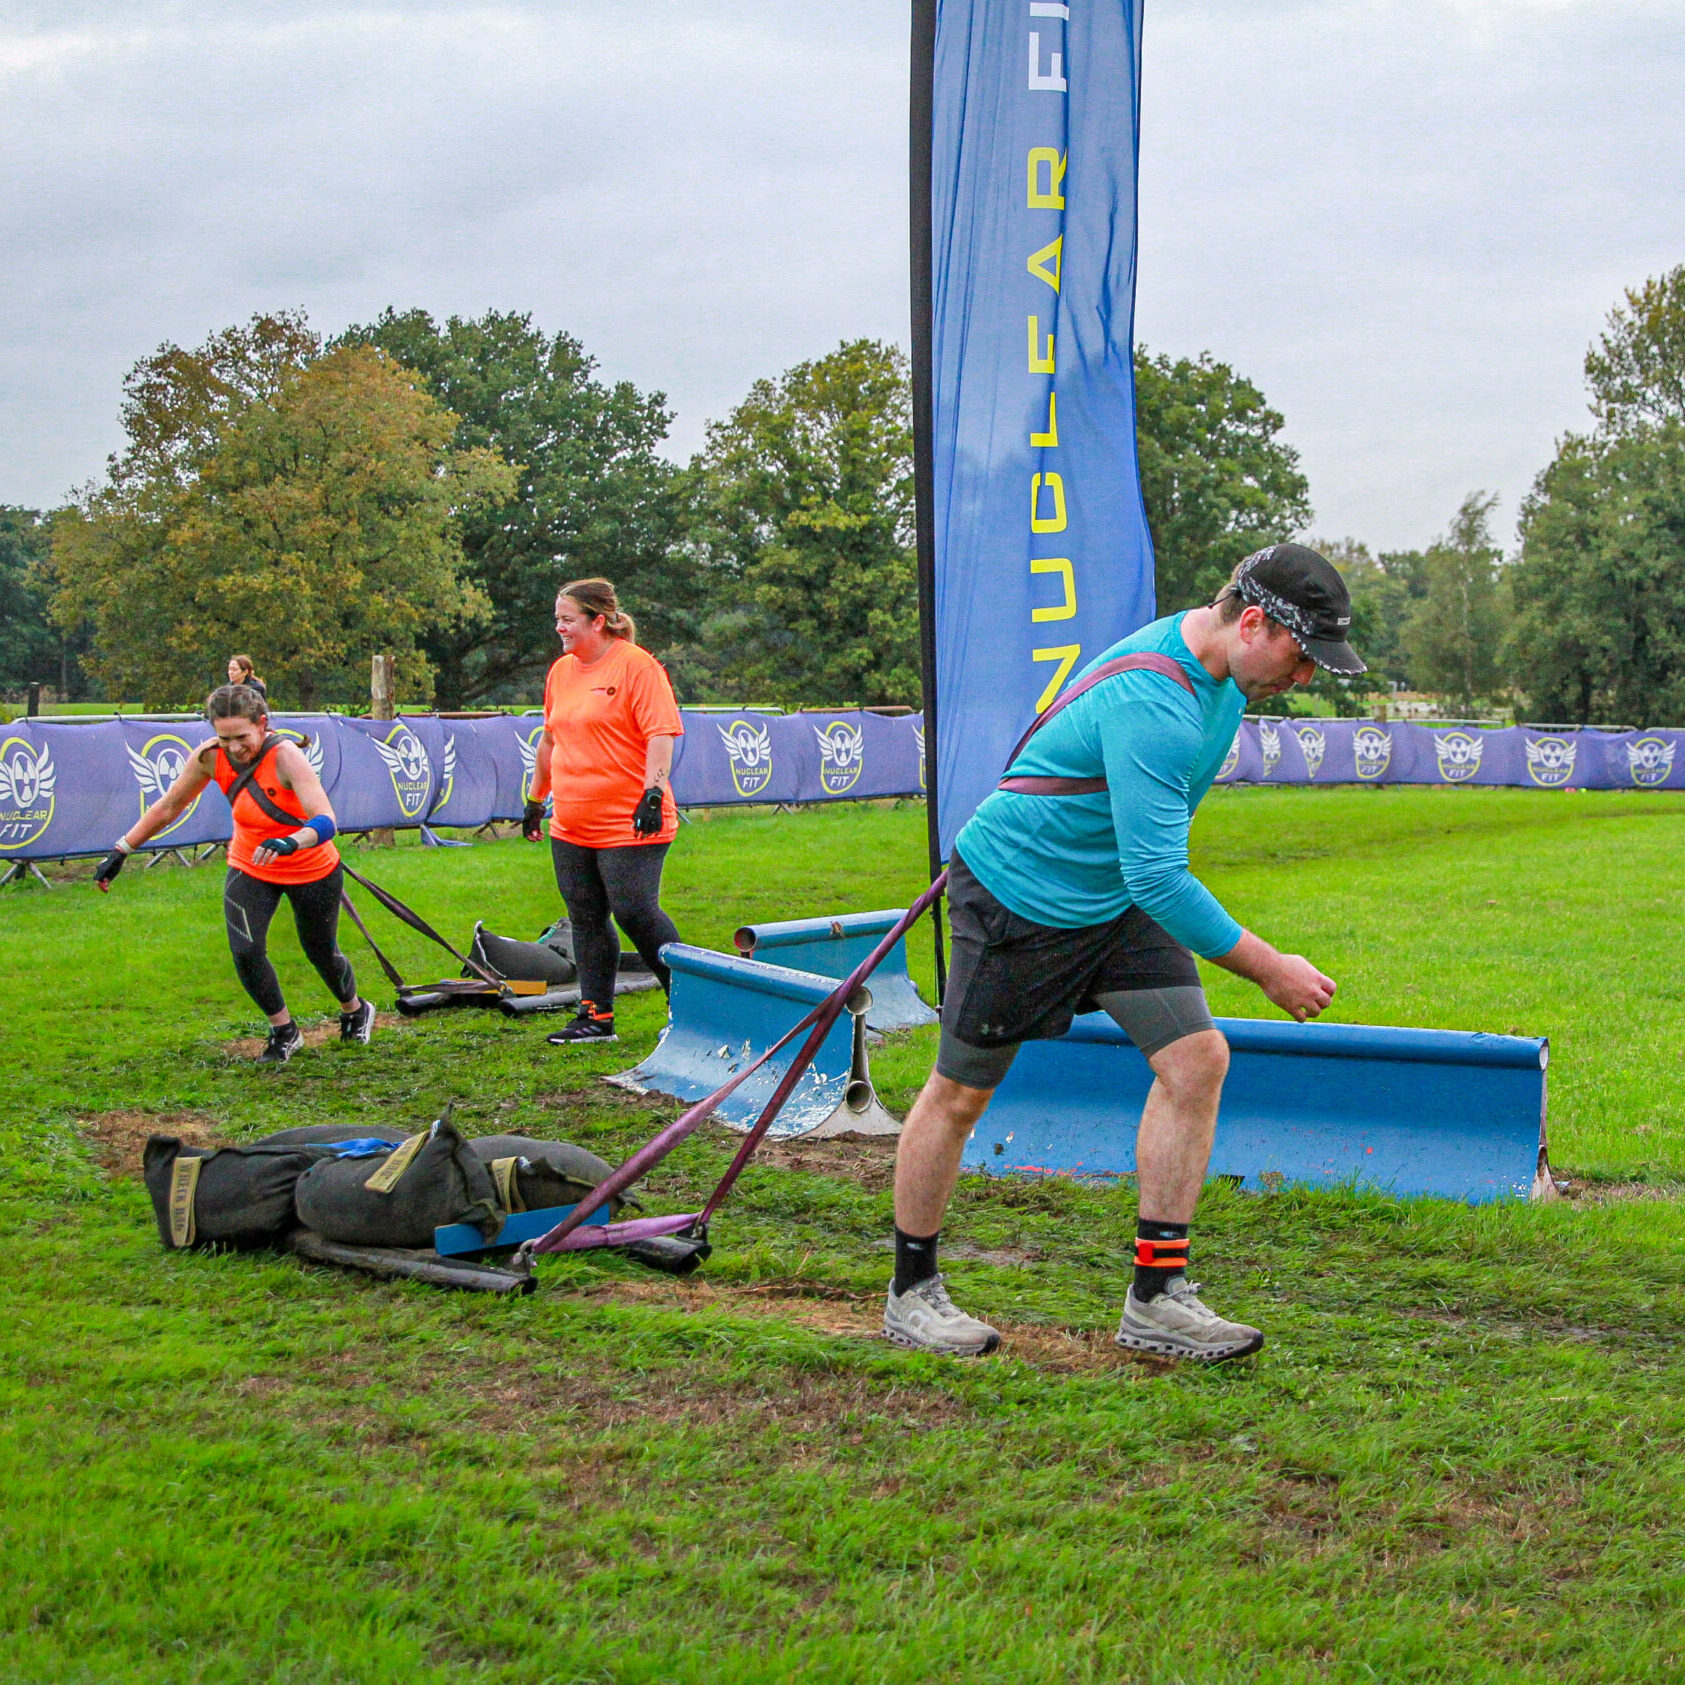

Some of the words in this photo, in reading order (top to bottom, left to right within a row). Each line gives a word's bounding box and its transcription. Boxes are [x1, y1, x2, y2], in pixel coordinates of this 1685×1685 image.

[1027, 146, 1081, 714] NUCLEAR
[735, 767, 769, 776] NUCLEAR
[824, 766, 858, 776] NUCLEAR
[397, 781, 429, 791] NUCLEAR
[742, 777, 760, 788] FIT
[830, 776, 850, 787] FIT
[405, 792, 421, 807] FIT
[0, 810, 48, 821] NUCLEAR
[0, 823, 33, 839] FIT
